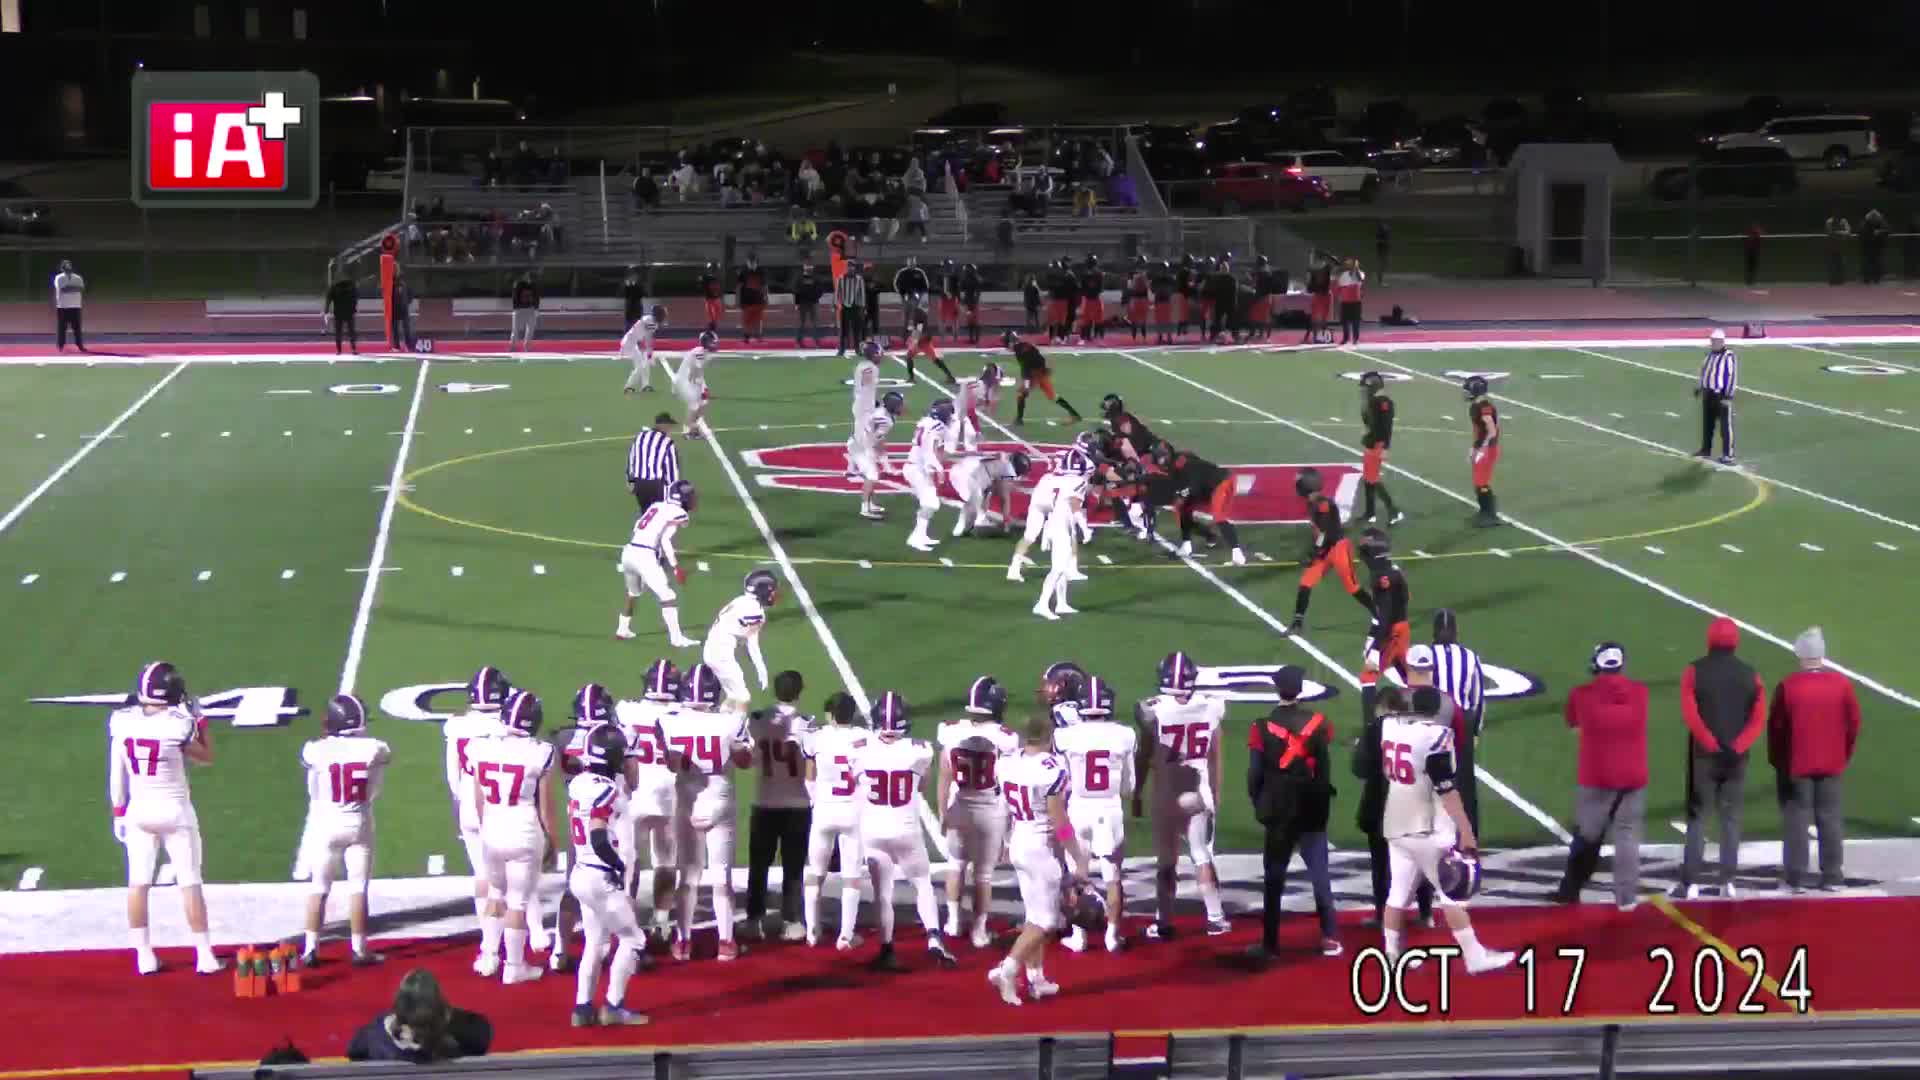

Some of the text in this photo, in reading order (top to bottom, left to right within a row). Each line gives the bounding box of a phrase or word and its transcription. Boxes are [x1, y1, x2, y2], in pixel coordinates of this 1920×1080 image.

[123, 738, 161, 776] 17
[670, 736, 723, 775] 74
[1161, 722, 1210, 762] 76
[329, 762, 369, 803] 16
[477, 762, 525, 807] 57
[866, 769, 914, 808] 30
[950, 747, 997, 790] 68
[1085, 750, 1111, 791] 6
[1003, 780, 1036, 821] 51
